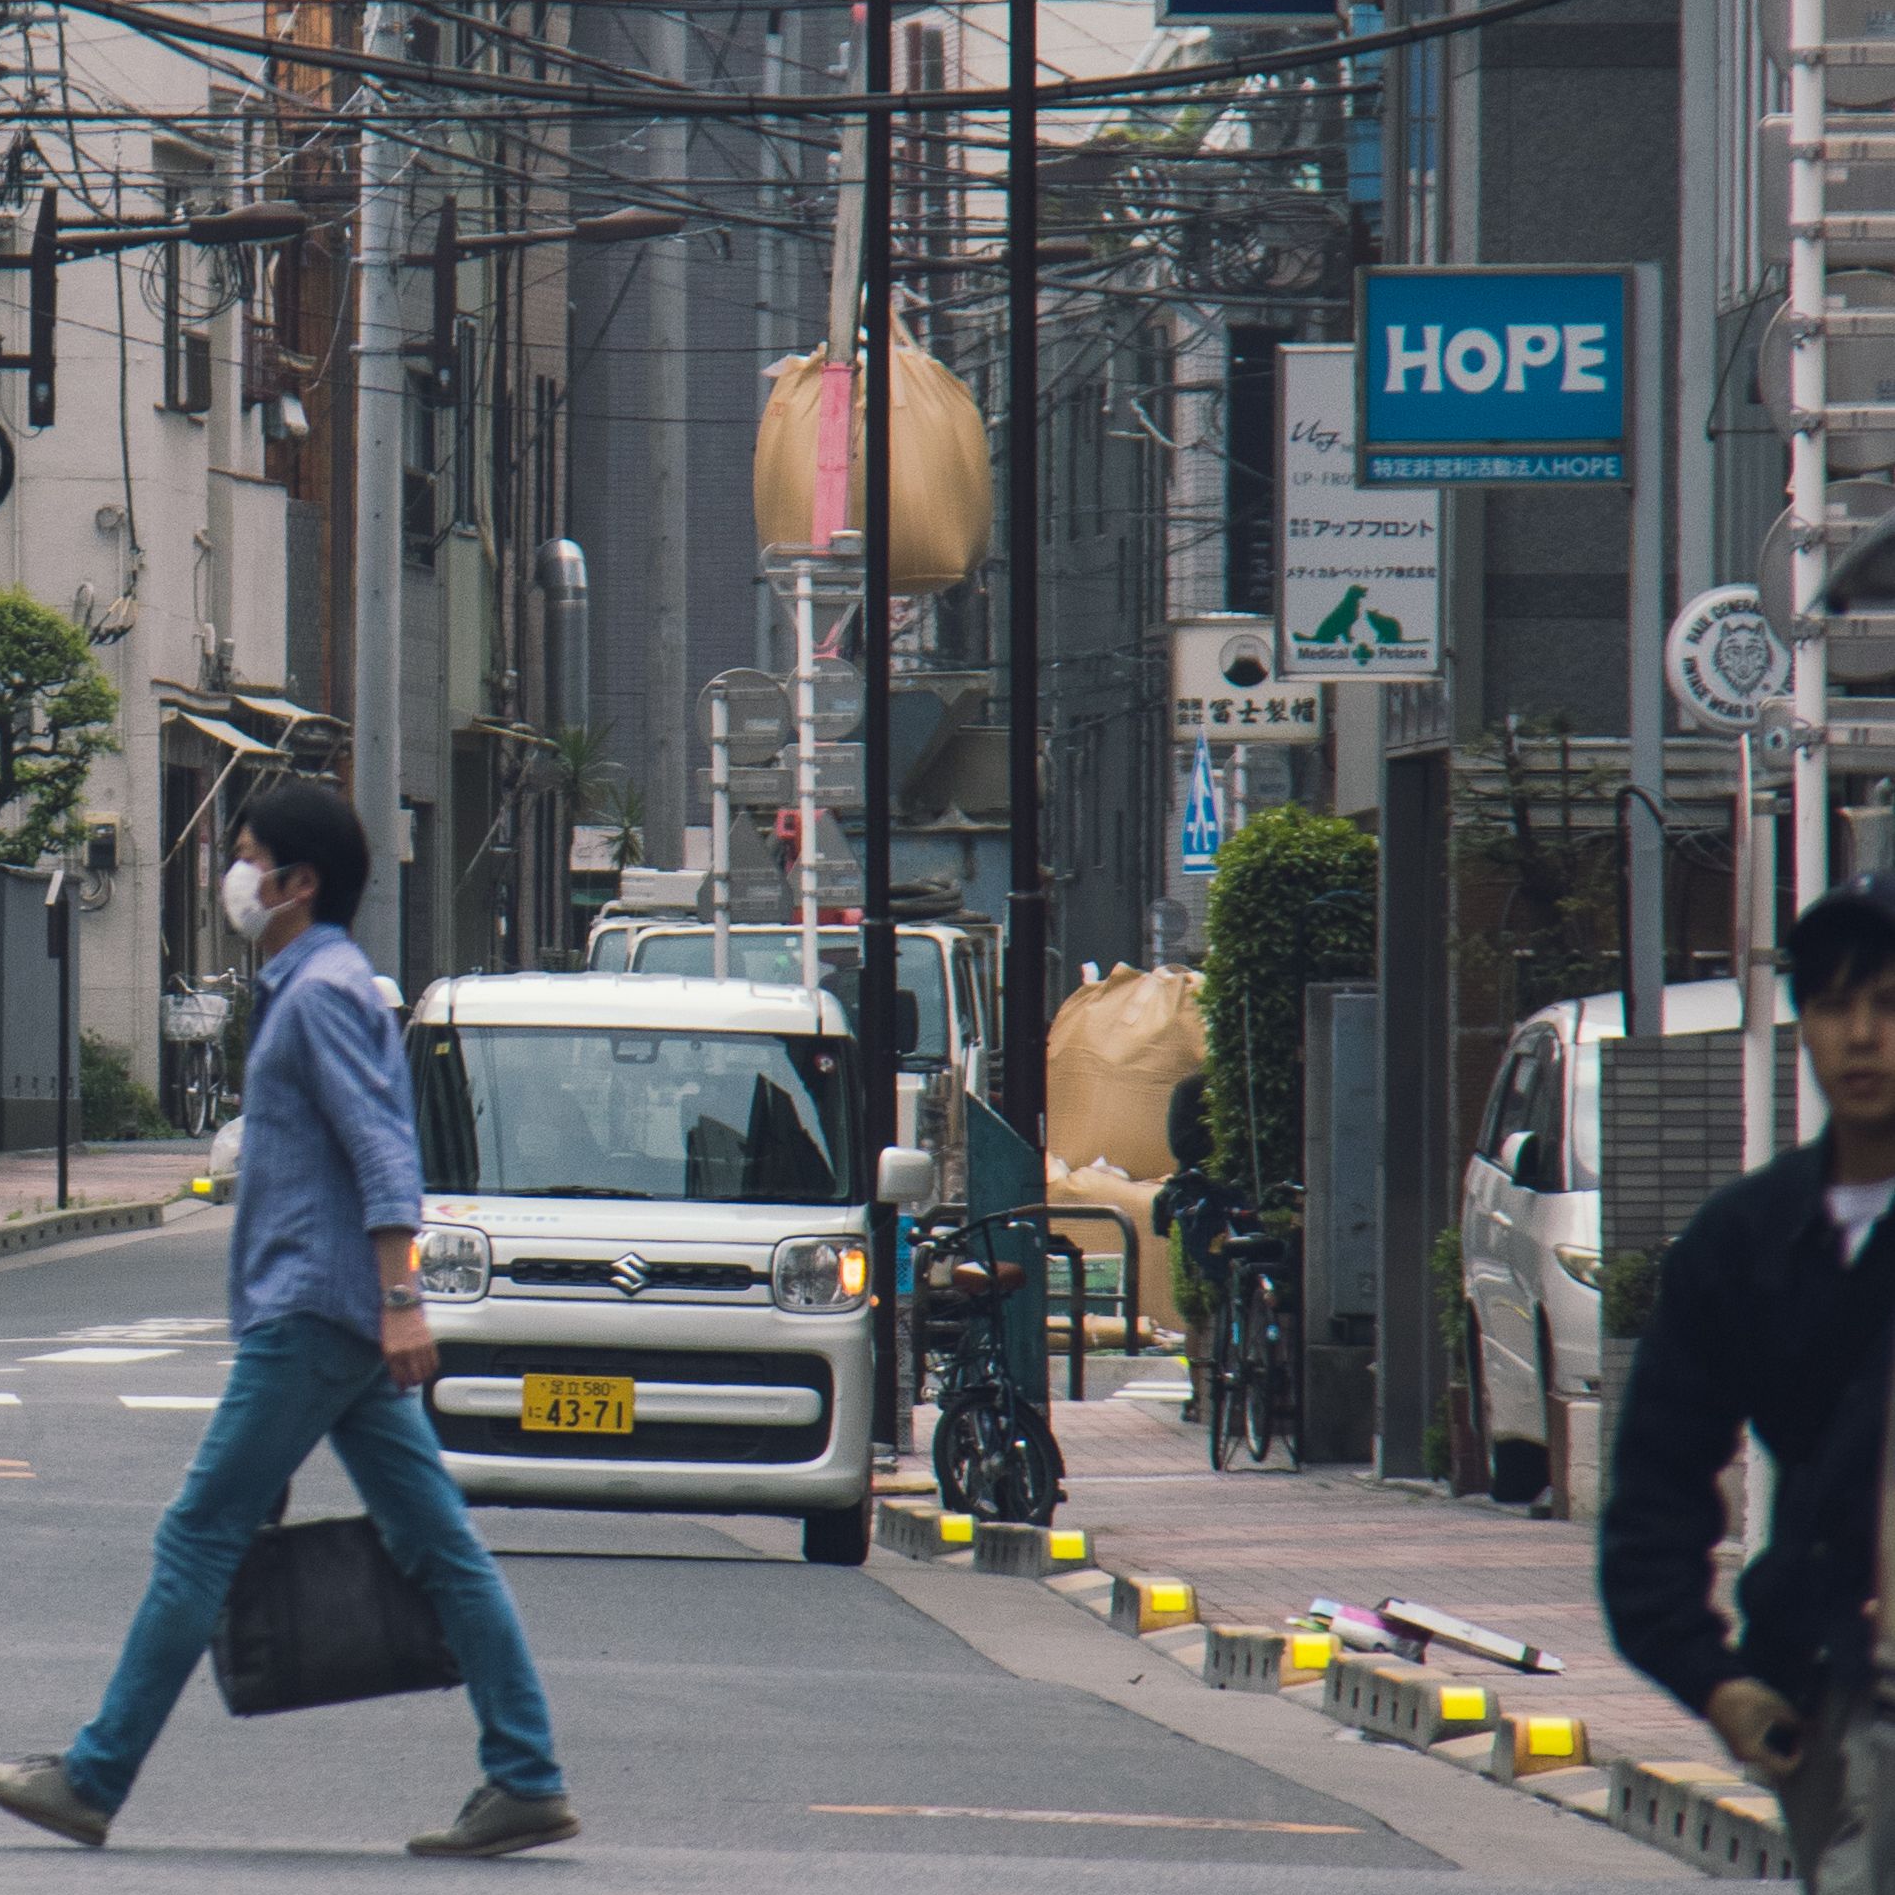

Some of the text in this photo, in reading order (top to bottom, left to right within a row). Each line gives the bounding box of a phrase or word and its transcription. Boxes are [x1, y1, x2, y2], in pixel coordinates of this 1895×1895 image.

[1384, 323, 1607, 394] HOPE
[1297, 646, 1428, 660] Medical Petcare
[547, 1398, 623, 1429] 43-71
